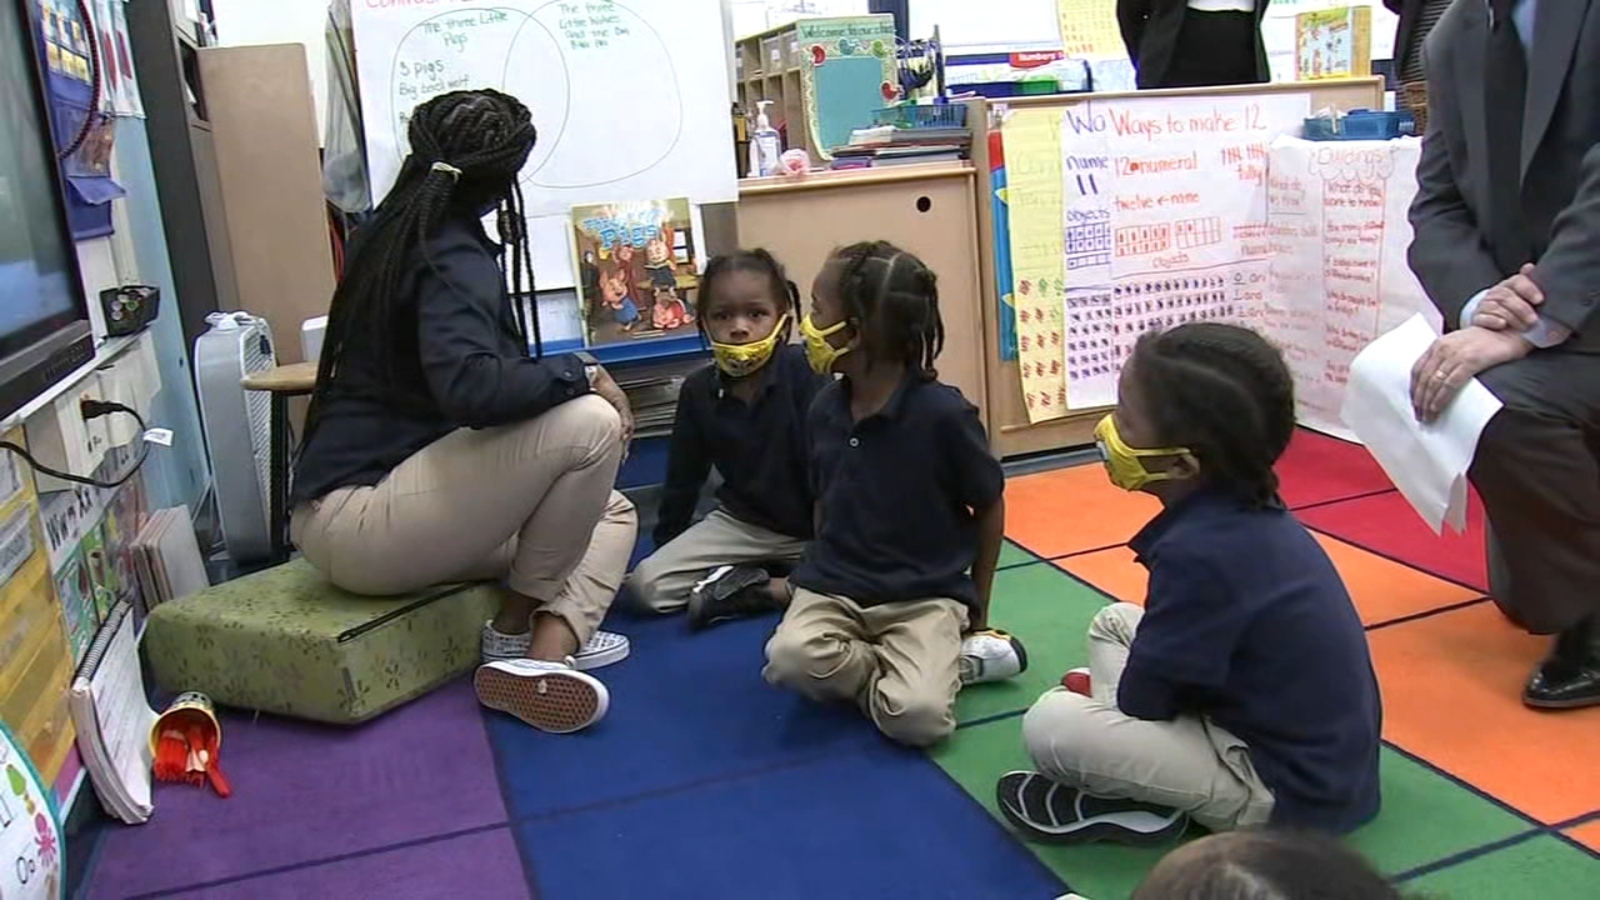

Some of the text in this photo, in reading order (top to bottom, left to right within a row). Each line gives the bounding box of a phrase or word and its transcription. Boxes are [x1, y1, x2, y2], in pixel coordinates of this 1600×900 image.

[801, 24, 845, 39] Welcome
[414, 60, 445, 82] pigs
[1109, 103, 1267, 140] Ways to make 12
